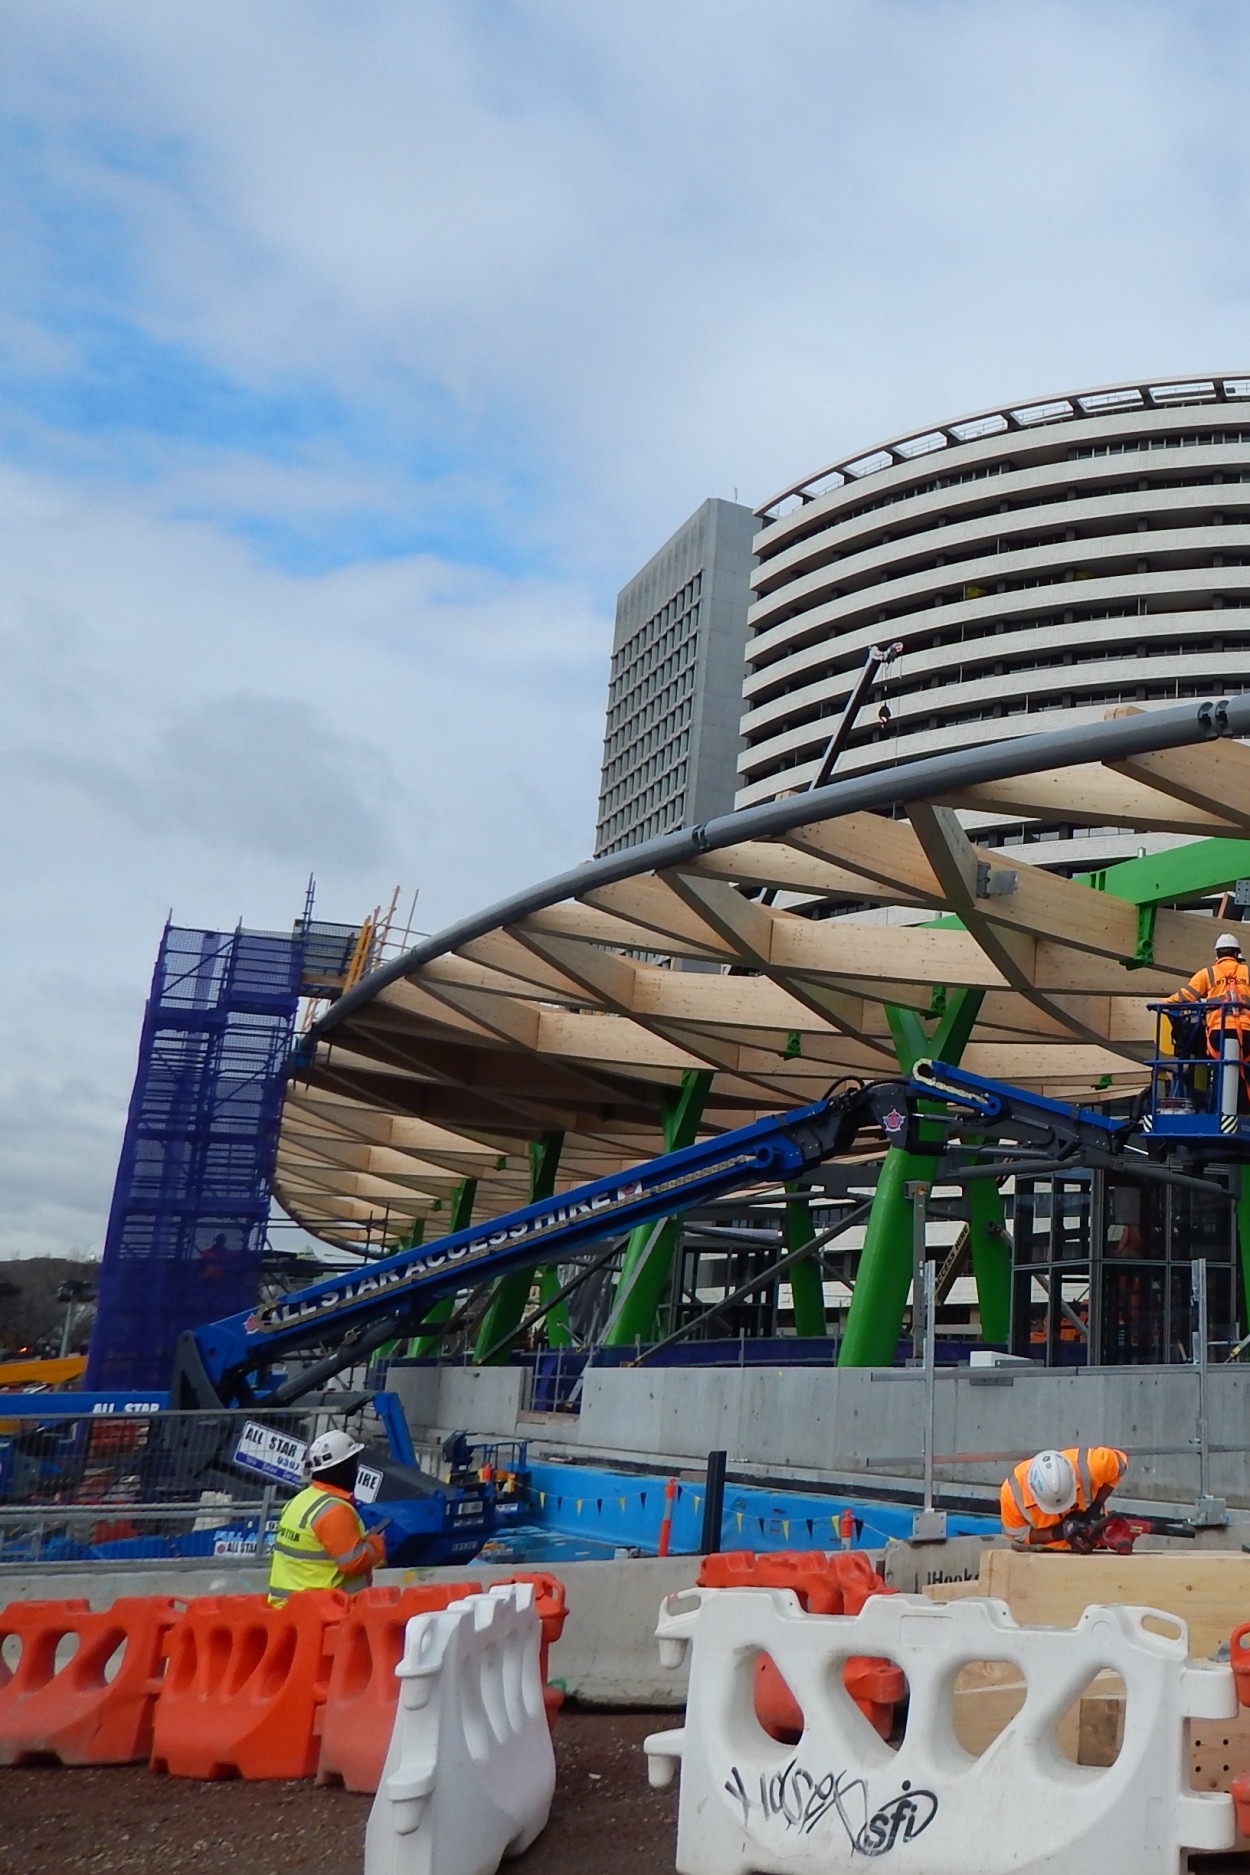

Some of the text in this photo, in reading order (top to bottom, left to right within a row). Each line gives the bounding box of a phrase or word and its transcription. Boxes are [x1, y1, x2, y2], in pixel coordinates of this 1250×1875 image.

[404, 1222, 529, 1279] ACCESS
[534, 1192, 612, 1230] HIRE
[92, 1402, 160, 1414] ALL STAR
[244, 1427, 264, 1445] ALL
[268, 1436, 298, 1458] STAR
[357, 1471, 378, 1490] IRE
